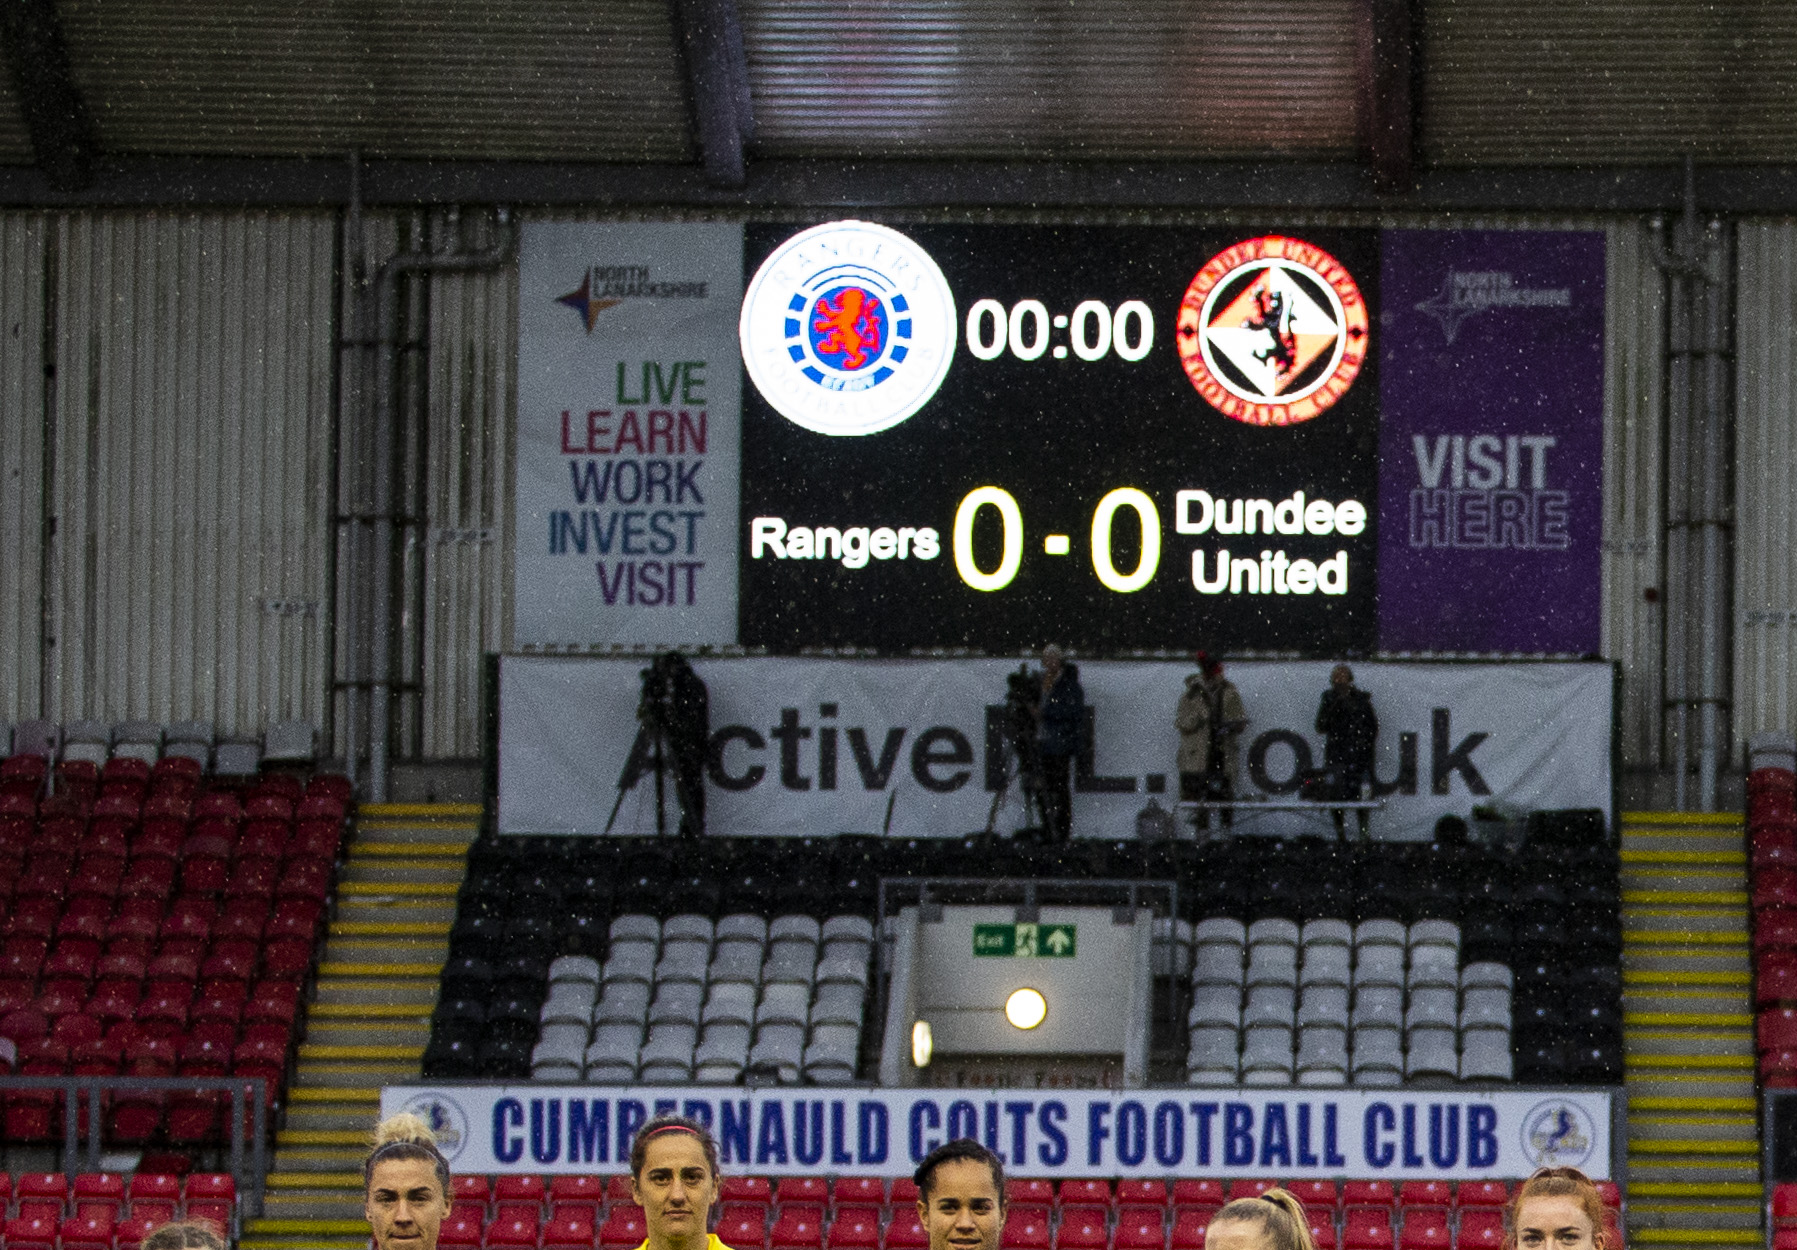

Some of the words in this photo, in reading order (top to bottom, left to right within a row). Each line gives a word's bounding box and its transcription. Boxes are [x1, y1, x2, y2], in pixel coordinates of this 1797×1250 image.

[593, 265, 649, 281] NORTH
[965, 298, 1155, 361] 00:00
[615, 361, 707, 406] LIVE
[560, 411, 707, 455] LEARN
[569, 460, 704, 503] WORK
[1412, 435, 1557, 490] VISIT
[548, 511, 704, 555] INVEST
[1175, 489, 1368, 536] Dundee
[1409, 488, 1571, 551] HERE
[750, 516, 940, 570] Rangers
[597, 561, 704, 607] VISIT
[1191, 548, 1348, 595] United
[1087, 1100, 1346, 1169] FOOTBALL
[1363, 1100, 1500, 1169] CLUB
